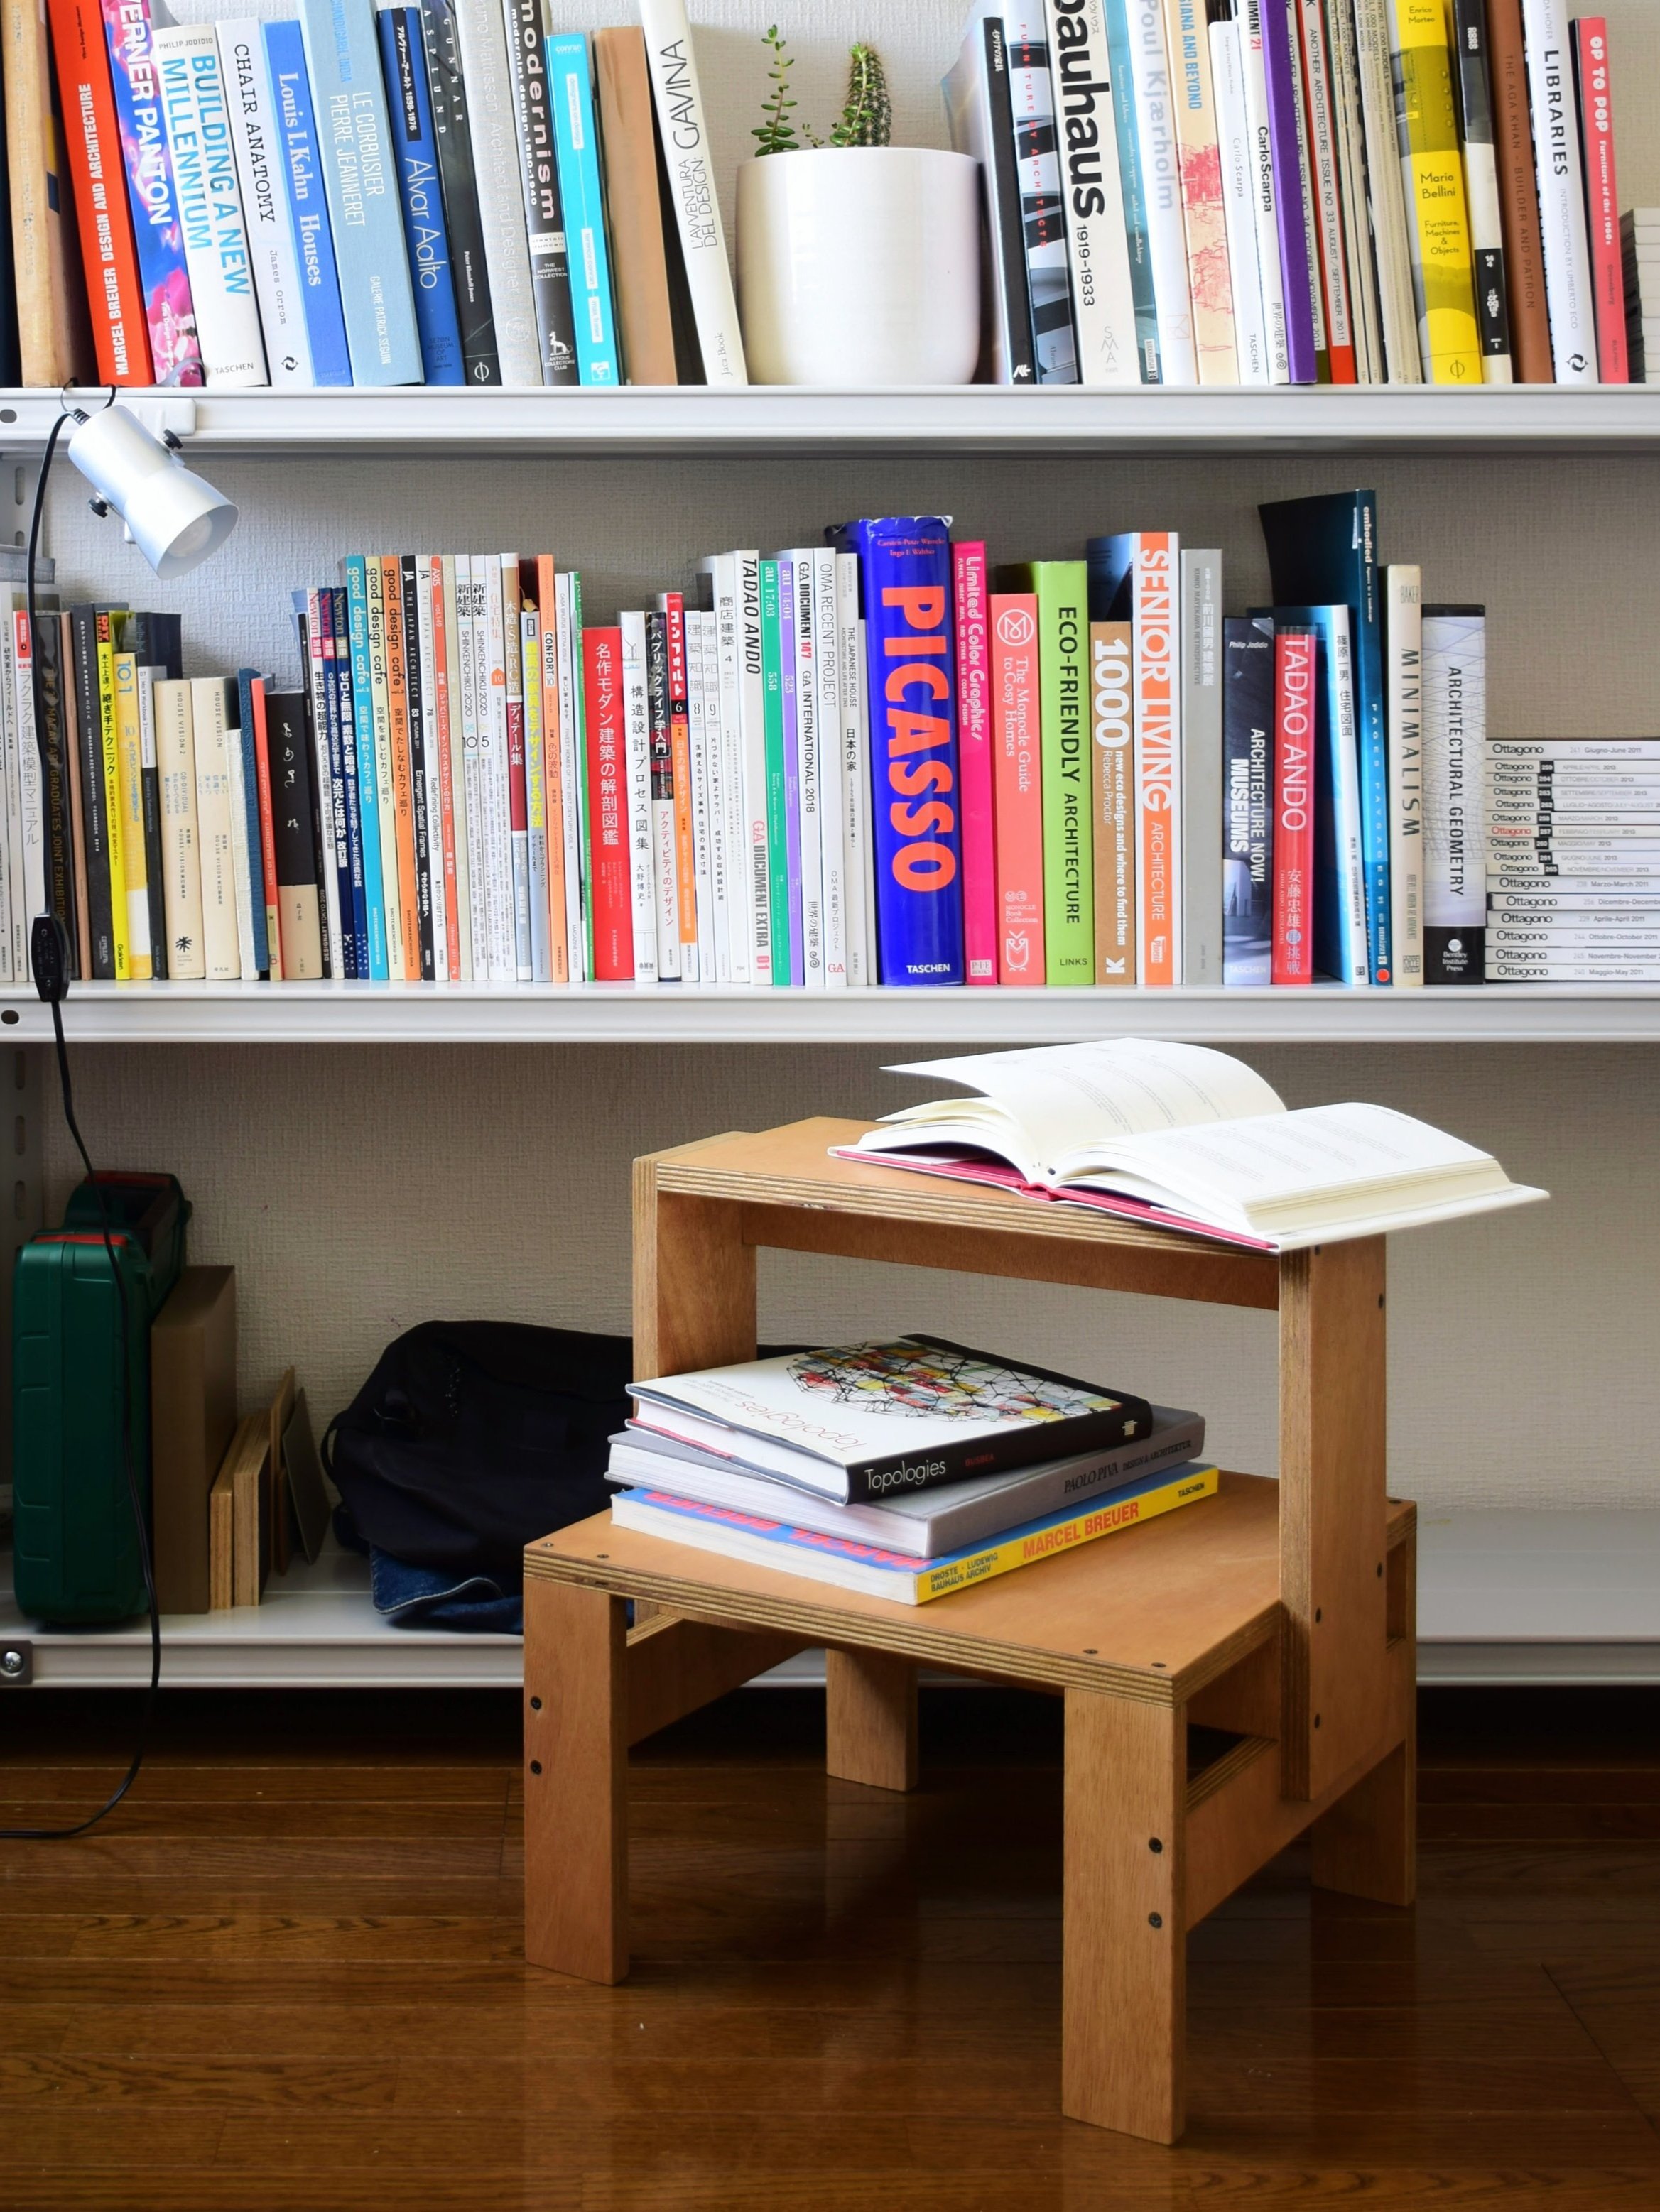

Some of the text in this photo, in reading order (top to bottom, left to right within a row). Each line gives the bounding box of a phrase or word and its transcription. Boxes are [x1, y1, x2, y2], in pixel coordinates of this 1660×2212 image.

[158, 37, 214, 50] PHILIP JODIDIO
[423, 10, 447, 134] ASPLUND
[444, 18, 463, 121] GUNNAR
[1182, 35, 1202, 109] AND BEYOND
[660, 39, 700, 149] GAVINA
[1544, 50, 1568, 176] LIBRARIES
[1590, 36, 1609, 183] OP TO POP Furniture
[162, 58, 212, 251] MILLENNIUM
[234, 43, 276, 224] CHAIR ANATOMY
[330, 94, 365, 226] PIERRE JEANNERET
[353, 92, 384, 197] LE CORBUSIER
[134, 109, 172, 225] PANTON
[192, 55, 251, 295] BUILDING A NEW
[278, 72, 320, 286] Louis Houses
[1421, 173, 1454, 184] Mario
[1422, 187, 1455, 199] Bellini
[79, 83, 129, 376] MARCEL BREUER DESIGN AND ARCHITECTURE
[405, 157, 447, 288] Alvar Aalto
[701, 219, 718, 247] DEL
[1431, 246, 1460, 255] Objects
[1520, 229, 1530, 259] AND
[369, 276, 384, 306] GALERIE
[1076, 225, 1095, 306] 1919-1933
[215, 361, 254, 375] TASCHEN
[1249, 334, 1259, 374] TASCHEN
[1363, 506, 1372, 563] embodied
[335, 593, 344, 634] Newton
[347, 567, 369, 684] good design cafe
[367, 568, 386, 684] good design cafe
[384, 569, 405, 686] good design cafe
[720, 596, 735, 647] 商店建築
[742, 559, 761, 675] TADAO ANDO
[820, 563, 836, 708] OMA RECENT PROJECT
[545, 632, 554, 675] CONFORT
[848, 643, 857, 708] JAPANESE HOUSE
[966, 557, 986, 740] Limited Color Graphics
[651, 632, 666, 754] パブリックライフ学入門
[798, 562, 815, 813] GA DOCUMENT GA INTERNATIONAL 2018
[1003, 657, 1017, 756] to Cosy Homes
[1095, 639, 1130, 748] 1000
[511, 704, 523, 766] ディテール集
[595, 643, 619, 845] 名作モダン建築の解剖図鑑
[846, 729, 857, 771] 日本の家
[882, 586, 955, 892] PICASSO
[1016, 656, 1031, 792] The Monocle Guide
[1140, 549, 1172, 920] SENIOR LIVING ARCHITECTURE
[1281, 634, 1308, 831] TADAO ANDO
[1401, 648, 1421, 836] MINIMALISM
[1492, 743, 1544, 756] Ottagono
[376, 707, 389, 805] 空間を楽しむカフェ巡り
[394, 708, 408, 816] 空間でたしなむカフェ巡り
[630, 685, 649, 850] 構造設計プロセス図集
[1058, 607, 1080, 923] ECO-FRIENDLY ARCHITECTURE
[1449, 667, 1464, 895] ARCHITECTURAL GEOMETRY
[1493, 773, 1532, 783] Ottagono
[1495, 762, 1534, 771] Ottagono
[415, 770, 423, 803] Emergent
[1102, 751, 1113, 824] Rebecca Proctor
[1114, 792, 1126, 831] designs
[1230, 758, 1249, 853] MUSEUMS
[1250, 729, 1265, 883] ARCHITECTURE NOW!
[1493, 788, 1532, 797] Ottagono
[1496, 800, 1534, 810] Ottagono
[1117, 833, 1126, 851] and
[1491, 838, 1529, 847] Ottagono
[1492, 813, 1531, 823] Ottagono
[1492, 826, 1531, 836] Ottagono
[661, 811, 674, 925] アクティビティのデザイン
[753, 821, 769, 947] GA DOCUMENT EXTRA
[1117, 853, 1127, 886] where
[1494, 852, 1532, 862] Ottagono
[1499, 877, 1551, 890] Ottagono
[1500, 864, 1539, 873] Ottagono
[1117, 899, 1127, 918] find
[1501, 912, 1553, 925] Ottagono
[1506, 895, 1558, 908] Ottagono
[1117, 920, 1127, 946] them
[1496, 949, 1547, 962] Ottagono
[1497, 930, 1548, 942] Ottagono
[828, 963, 845, 973] GA
[906, 964, 950, 974] TASCHEN
[1497, 965, 1548, 978] Ottagono
[735, 1400, 867, 1453] Topologies
[864, 1459, 946, 1493] Topologies
[1064, 1462, 1119, 1494] PAOLO PIVA
[1178, 1482, 1205, 1498] TASCHEN
[1023, 1502, 1139, 1560] MARCEL BREUER
[931, 1552, 999, 1584] DROSTE LUDEWIG
[931, 1564, 992, 1593] BAUHAUS ARCHIV
